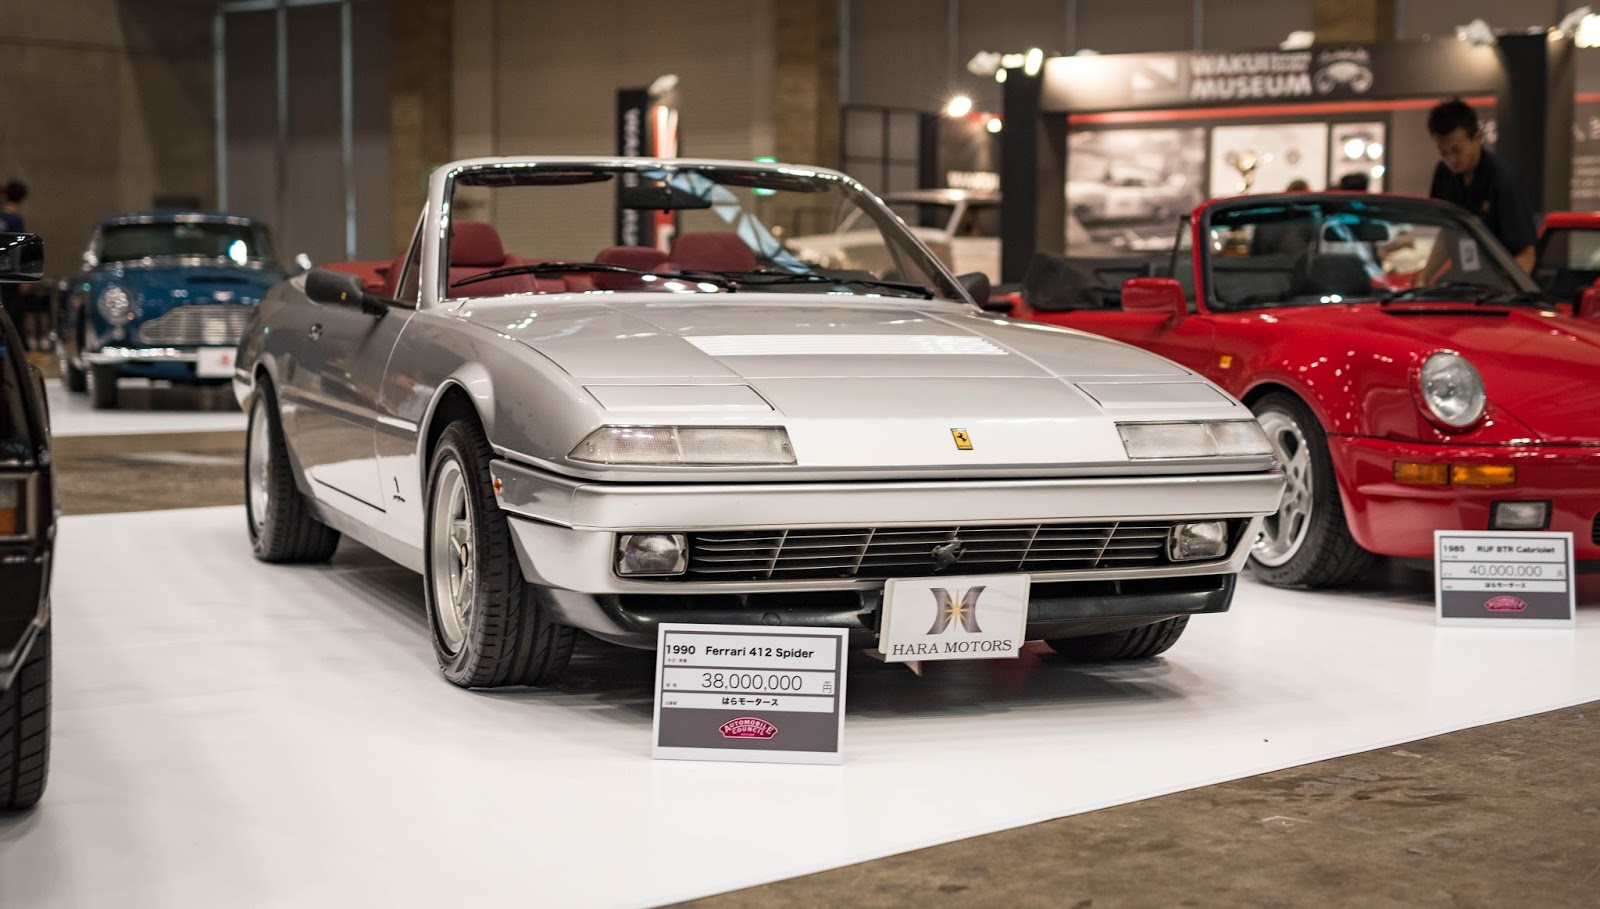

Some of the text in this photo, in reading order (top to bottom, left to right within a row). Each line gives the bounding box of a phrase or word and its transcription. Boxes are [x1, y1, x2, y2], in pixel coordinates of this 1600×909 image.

[1190, 73, 1313, 99] MUSEUM
[666, 645, 814, 659] 1990 Ferrari 412 Spider
[892, 639, 1012, 656] HARA MOTORS
[701, 672, 803, 691] 38,000,000
[722, 697, 778, 706] はらモータース
[724, 719, 774, 734] AUTOMOBILE
[731, 726, 764, 736] COUNCIL
